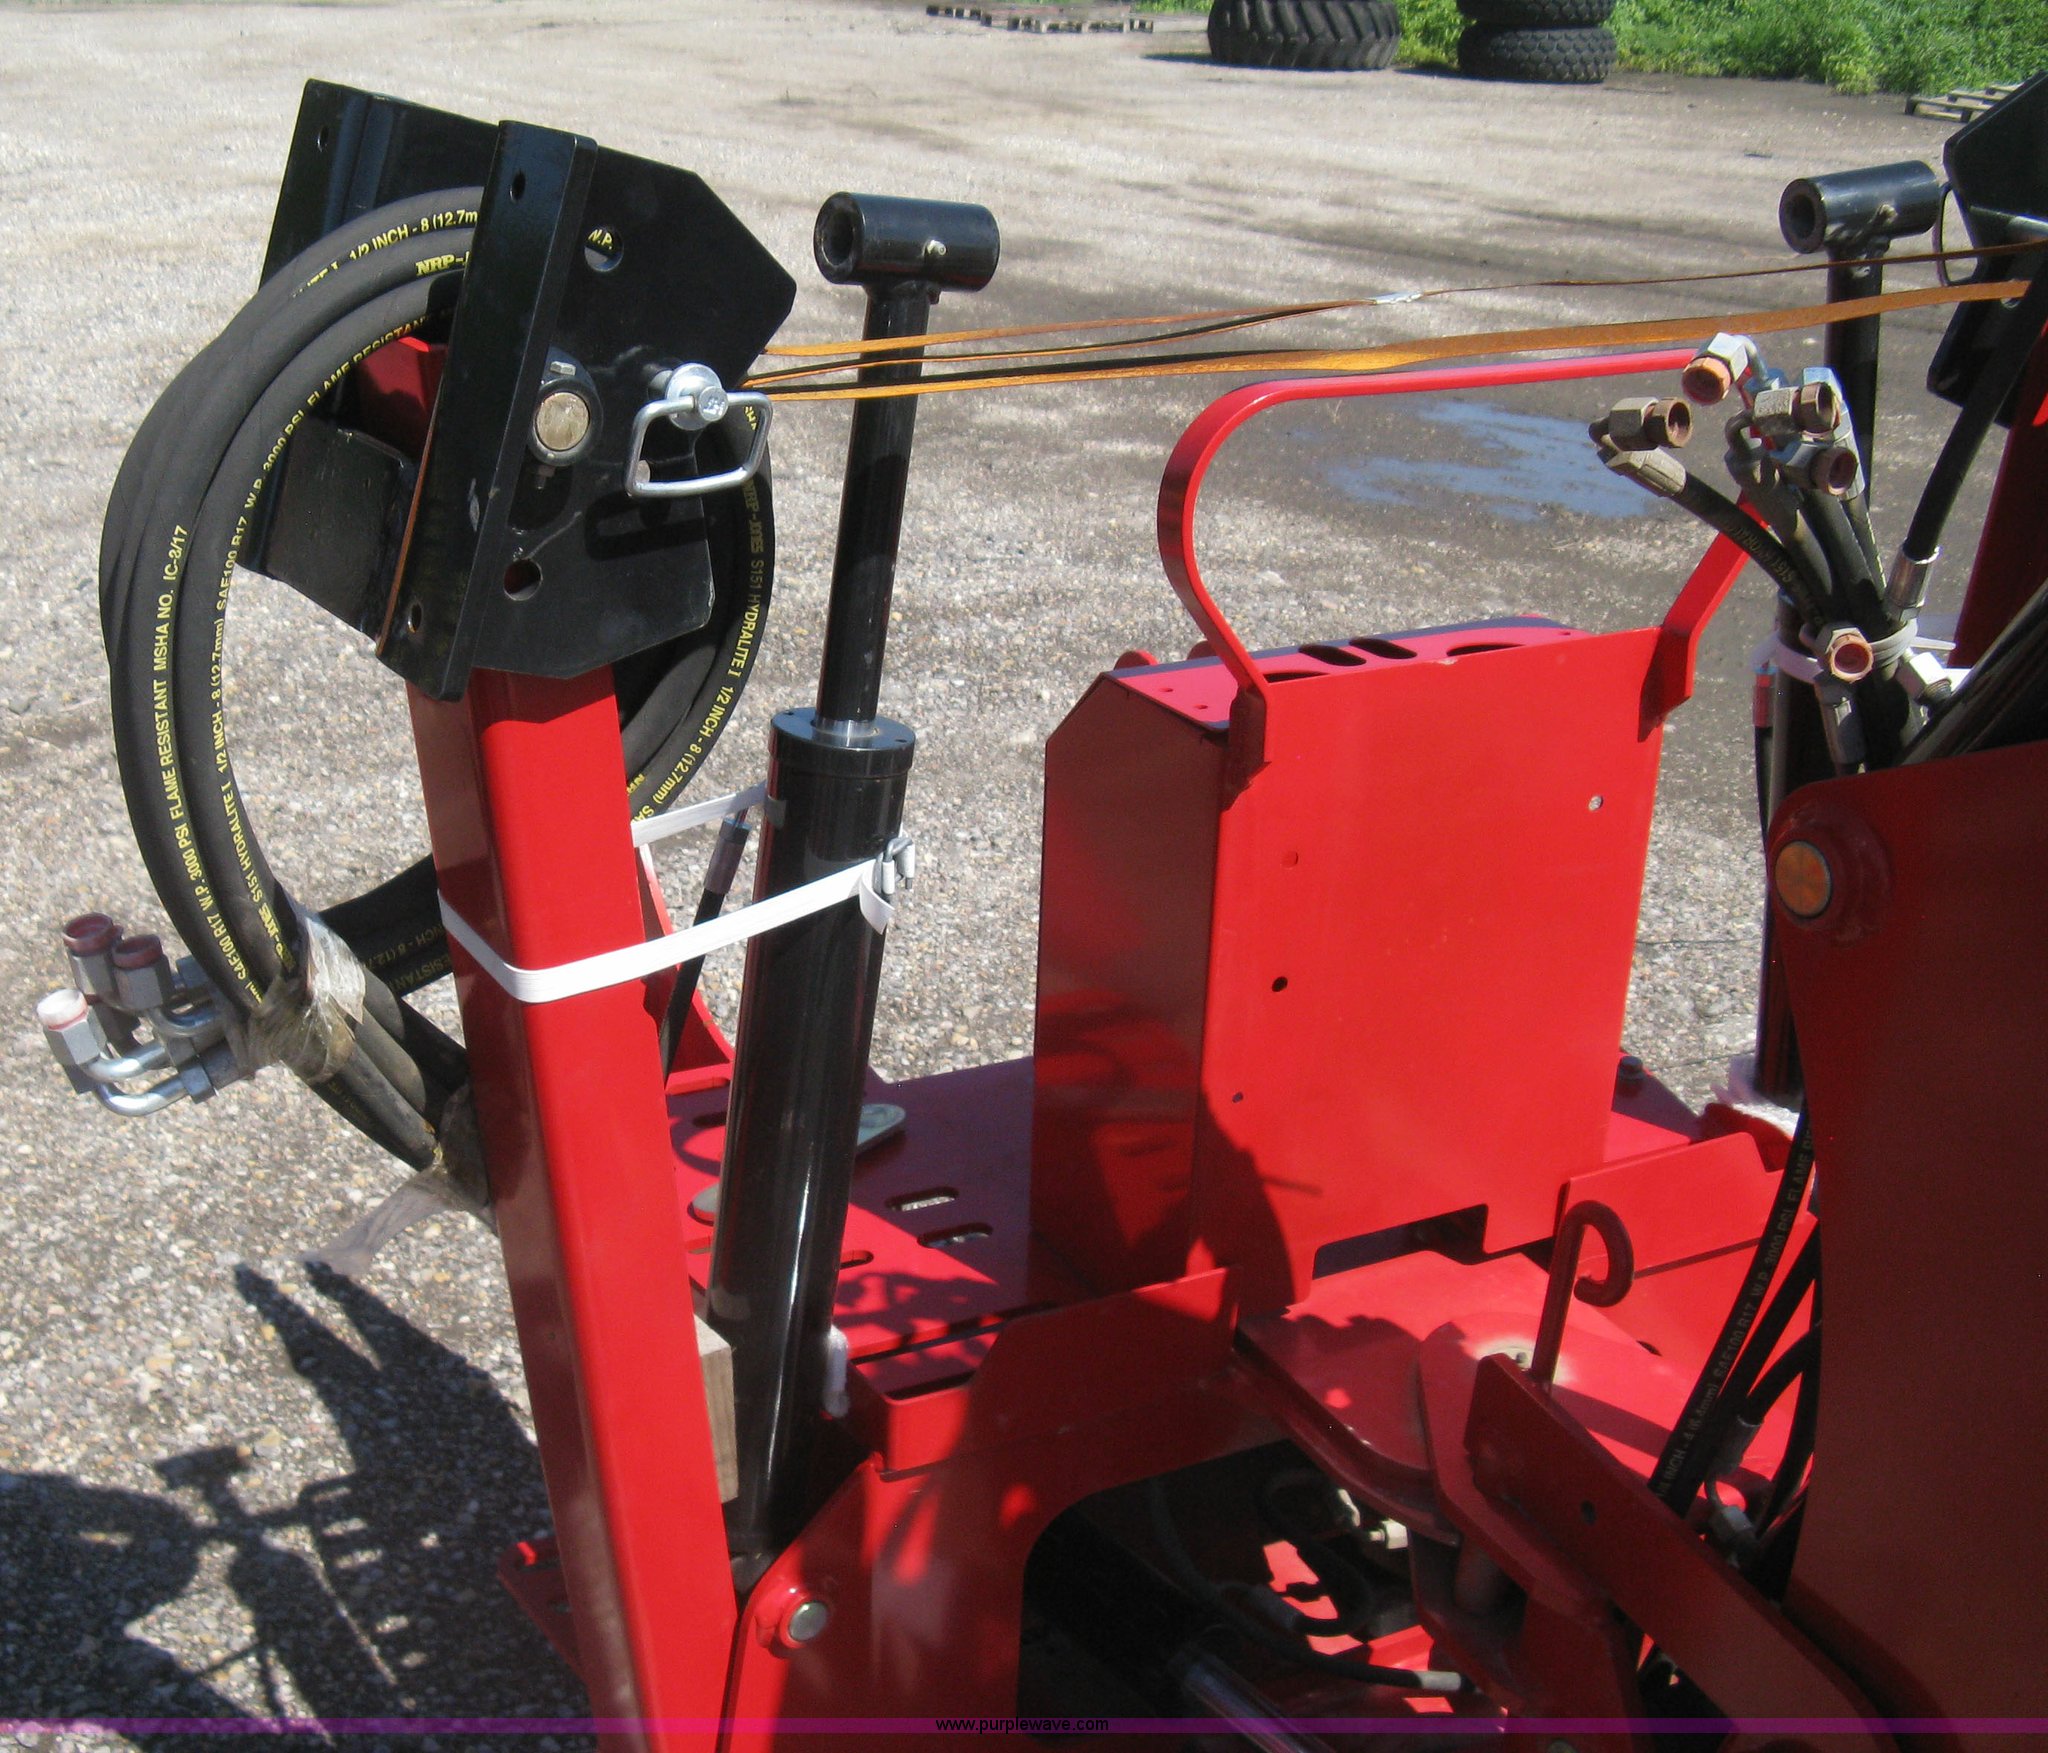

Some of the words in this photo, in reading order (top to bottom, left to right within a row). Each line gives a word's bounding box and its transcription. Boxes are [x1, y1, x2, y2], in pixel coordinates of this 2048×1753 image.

[371, 223, 410, 251] INCH
[421, 217, 430, 233] 8
[231, 515, 248, 547] R17
[750, 560, 765, 590] S151
[157, 589, 175, 619] NO.
[153, 622, 170, 671] MSHA
[731, 593, 762, 669] HYDRALITE
[211, 688, 222, 700] 8
[716, 686, 735, 705] 1/2
[153, 679, 174, 767] RESISTANT
[212, 709, 226, 750] INCH
[698, 704, 727, 738] INCH
[689, 743, 702, 755] 8
[162, 766, 185, 821] FLAME
[652, 752, 696, 805] (12.7mm)
[174, 822, 193, 849] PSI
[223, 790, 252, 872] HYDRALITE
[182, 848, 203, 880] 3000
[245, 870, 263, 903] S151
[206, 912, 227, 938] R17
